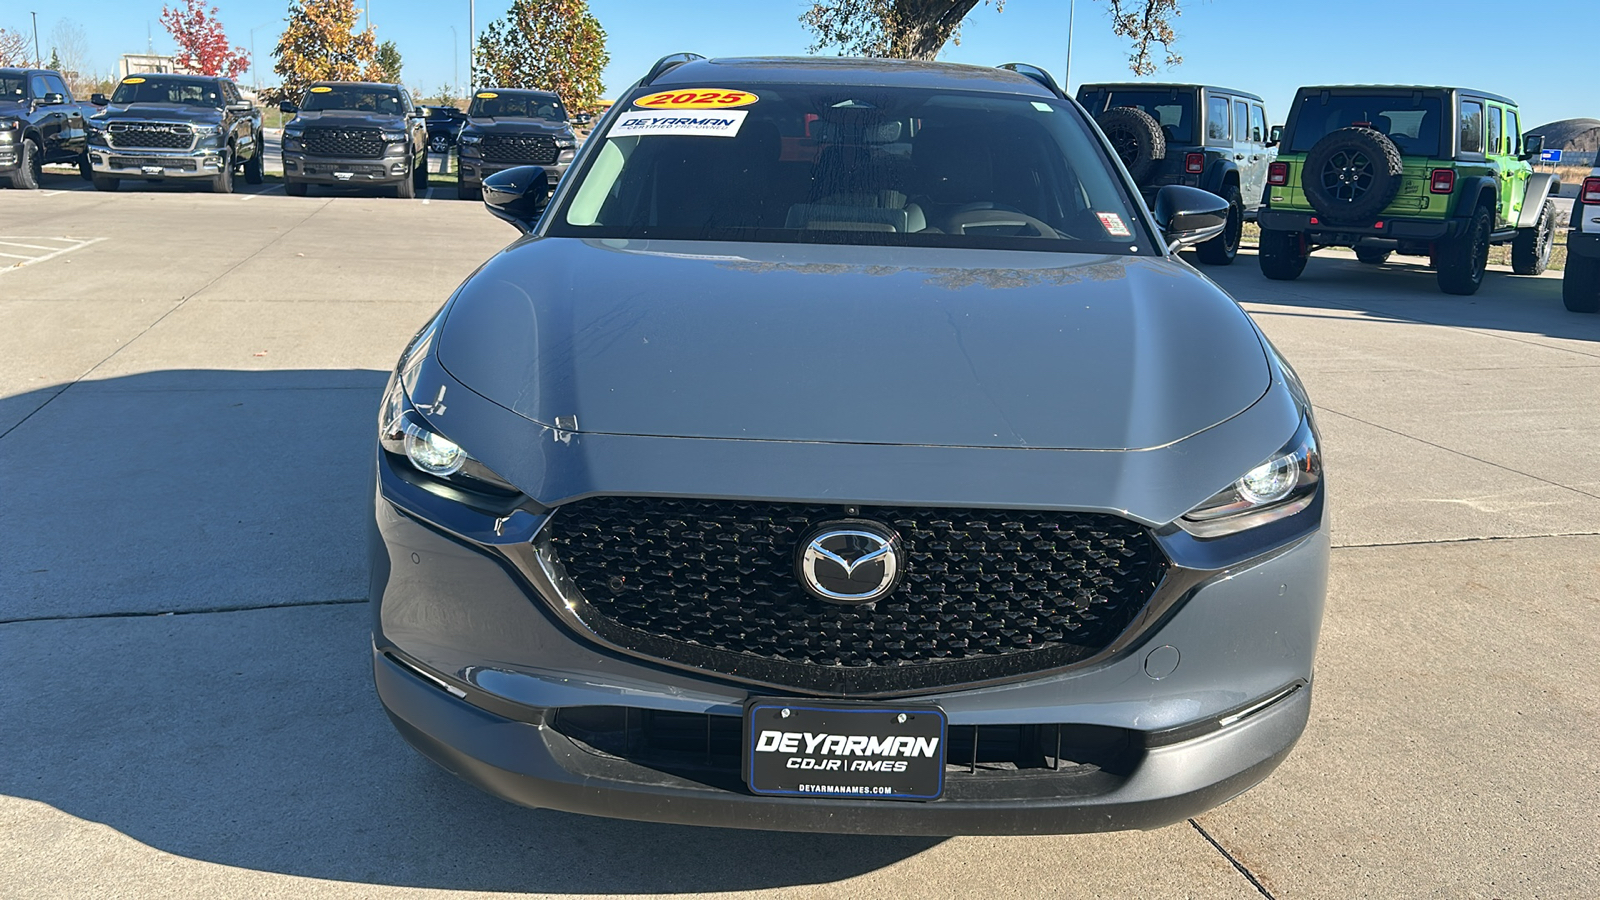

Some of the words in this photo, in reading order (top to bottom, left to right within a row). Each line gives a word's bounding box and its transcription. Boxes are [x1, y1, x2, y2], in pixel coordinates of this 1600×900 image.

[645, 93, 747, 105] 2025
[622, 118, 736, 127] DEYARMAN
[755, 730, 940, 758] DEYARMAN
[786, 757, 842, 771] CDJR
[850, 760, 908, 772] AMES
[799, 784, 892, 794] DEYARMANAMES.COM
